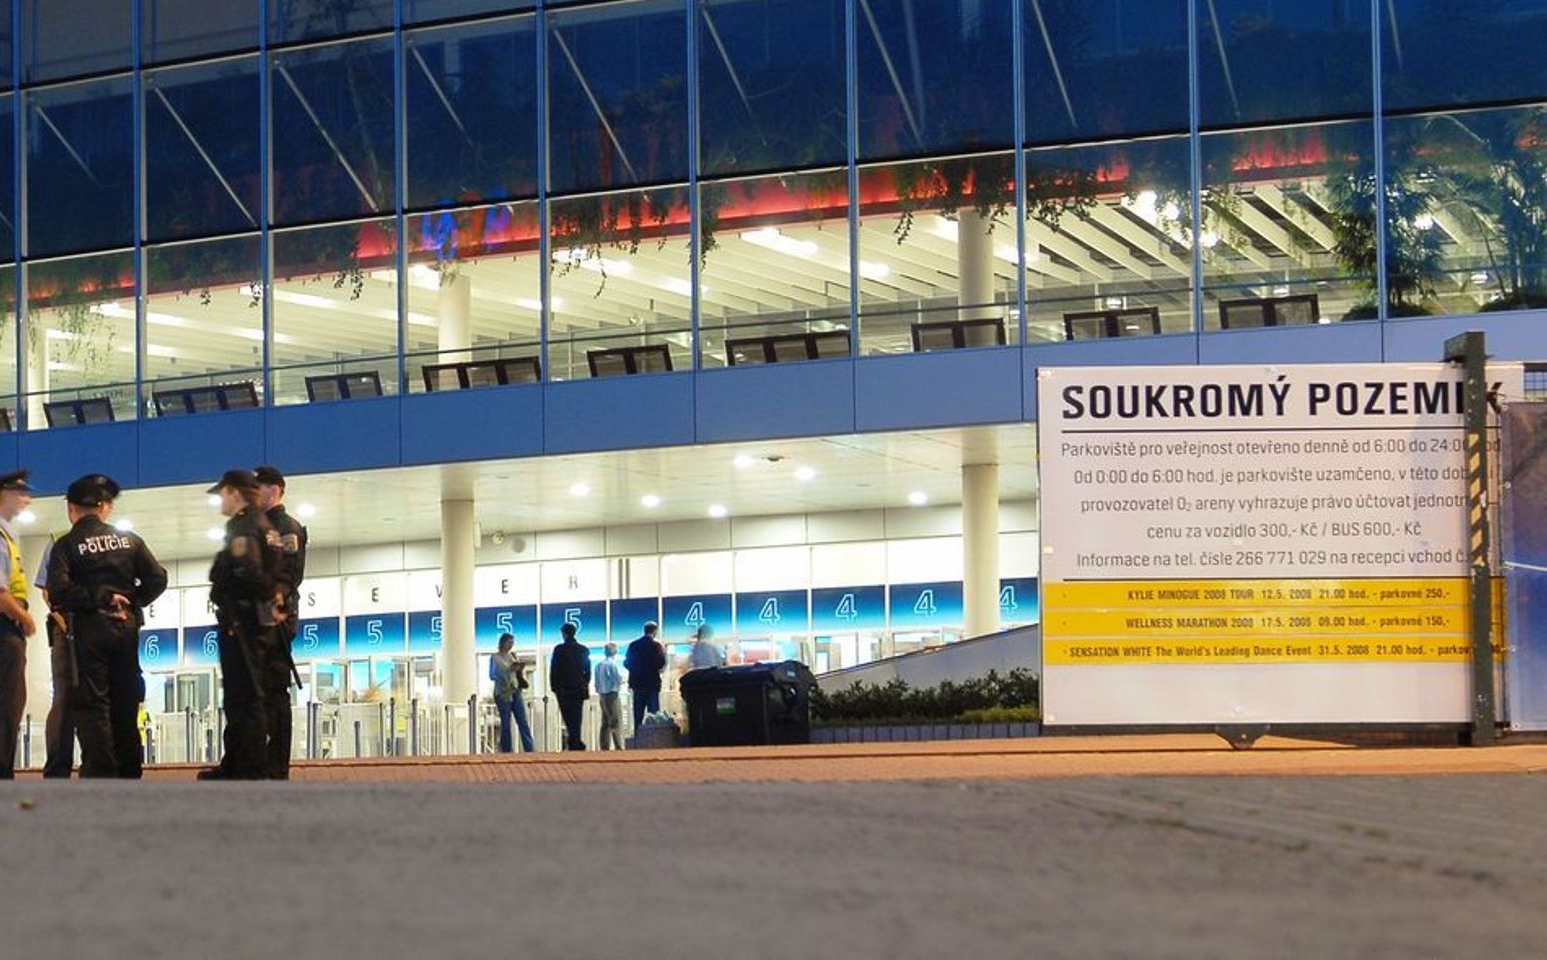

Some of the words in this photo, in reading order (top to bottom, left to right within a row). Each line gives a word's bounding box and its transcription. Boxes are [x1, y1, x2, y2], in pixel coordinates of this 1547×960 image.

[1062, 376, 1292, 419] SOUKROMÝ
[1061, 442, 1136, 457] Parkoviště
[1139, 444, 1163, 459] pro
[1166, 440, 1232, 458] veřejnost
[1236, 439, 1300, 455] otevřeno
[1303, 439, 1349, 454] denně
[1352, 438, 1370, 453] od
[1374, 438, 1404, 453] 6:00
[1408, 438, 1427, 453] do
[1131, 469, 1149, 484] do
[1152, 468, 1183, 483] 6:00
[1186, 468, 1218, 483] hod.
[1220, 469, 1234, 486] je
[1399, 470, 1407, 481] v
[1410, 466, 1439, 481] této
[1442, 465, 1470, 480] dob
[1081, 496, 1173, 514] provozovatel
[1195, 498, 1235, 513] areny
[1238, 494, 1308, 513] vyhrazuje
[1311, 494, 1353, 511] právo
[1355, 493, 1411, 509] účtovat
[1147, 526, 1182, 539] cenu
[1186, 526, 1202, 539] za
[1205, 523, 1257, 539] vozidlo
[1300, 521, 1318, 538] Kč
[1331, 522, 1360, 537] BUS
[1404, 520, 1422, 536] Kč
[77, 536, 131, 556] POLICIE
[1077, 552, 1150, 568] Informace
[1153, 554, 1171, 567] na
[1175, 551, 1196, 566] tel.
[1236, 550, 1263, 566] 266
[1266, 550, 1294, 566] 771
[1298, 549, 1327, 565] 029
[1330, 551, 1348, 565] na
[1351, 549, 1405, 567] recepci
[1408, 548, 1452, 564] vchod
[834, 593, 858, 622] 4
[913, 589, 937, 617] 4
[998, 585, 1018, 615] 4
[1127, 589, 1154, 601] KYLIE
[1157, 588, 1200, 600] MINOGUE
[1203, 589, 1226, 600] 2008
[1230, 588, 1254, 600] TOUR
[1289, 588, 1312, 600] 2008
[1319, 588, 1346, 600] 21.00
[1380, 588, 1423, 601] parkovné
[684, 601, 706, 630] 4
[758, 597, 782, 626] 4
[1126, 617, 1174, 629] WELLNESS
[1177, 617, 1228, 628] MARATHON
[1380, 615, 1423, 628] parkovné
[203, 630, 219, 657] 6
[303, 623, 319, 651] 5
[366, 619, 383, 647] 5
[144, 634, 160, 661] 6
[1069, 646, 1120, 658] SENSATION
[1123, 646, 1152, 657] WHITE
[1156, 645, 1173, 657] The
[1176, 645, 1211, 657] World's
[1214, 645, 1251, 659] Leading
[1254, 644, 1283, 657] Dance
[1286, 644, 1312, 656] Event
[1346, 644, 1370, 656] 2008
[1376, 643, 1403, 655] 21.00
